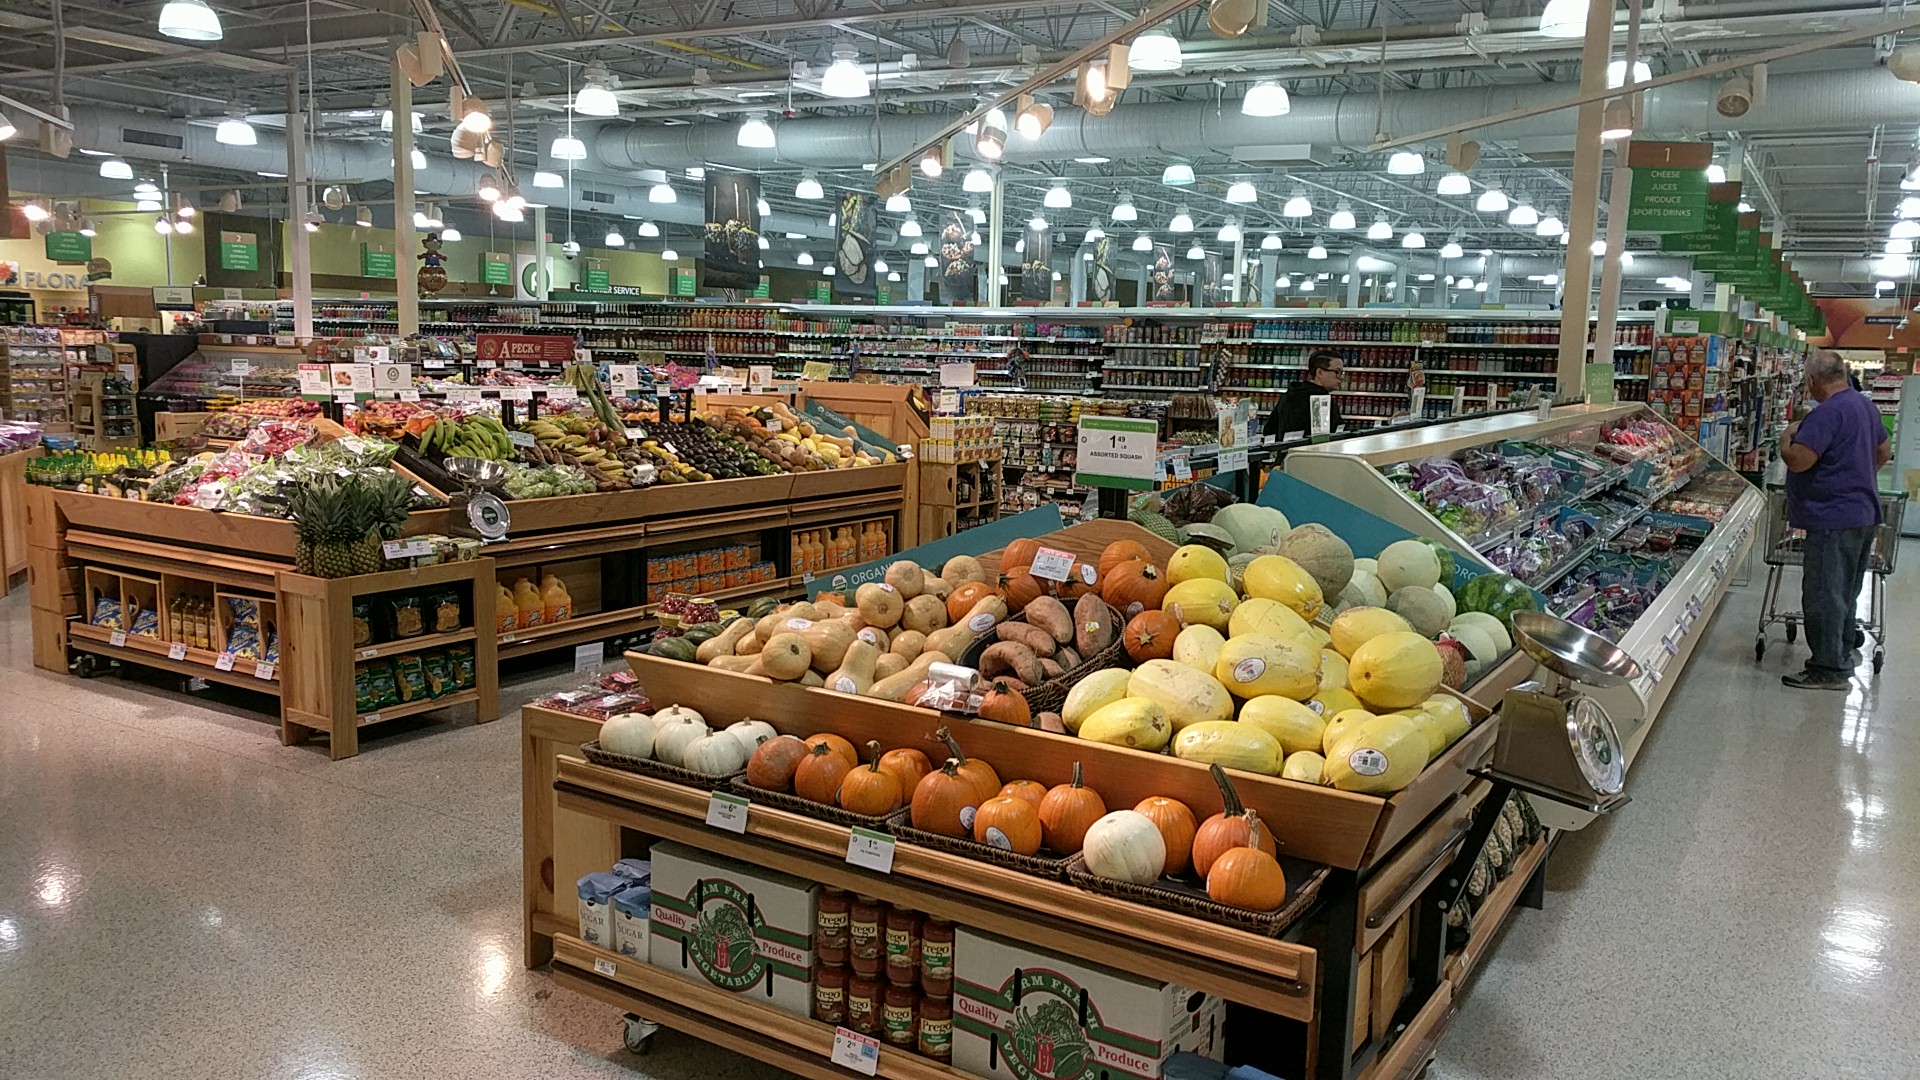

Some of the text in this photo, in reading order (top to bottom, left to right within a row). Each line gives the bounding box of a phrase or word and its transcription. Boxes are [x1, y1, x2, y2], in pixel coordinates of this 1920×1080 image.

[1664, 147, 1671, 162] 1
[1650, 170, 1681, 179] CHEESE
[1651, 183, 1677, 191] JUICES
[1644, 196, 1681, 204] PRODUCE
[1632, 208, 1691, 217] SPORTS DRINKS
[613, 285, 641, 296] SERVICE
[498, 340, 511, 359] A
[511, 342, 535, 354] PECK
[796, 412, 820, 428] ORGANIC
[824, 411, 847, 426] ORGANIC
[1109, 434, 1116, 449] 1
[1089, 451, 1143, 460] ASSORTED SQUASH
[1656, 518, 1692, 528] ORGANIC
[687, 883, 764, 929] FRM FREH
[579, 910, 605, 927] SUGAR
[655, 906, 687, 929] Quality
[818, 911, 847, 929] Prego
[615, 920, 645, 940] SUGAR
[886, 931, 907, 946] rego
[762, 941, 803, 963] Produce
[921, 939, 950, 959] Prego
[690, 941, 762, 987] VEGETABLES
[849, 999, 869, 1013] rego
[958, 997, 1000, 1024] Quality
[1003, 974, 1100, 1031] FRM FREH
[921, 1018, 952, 1035] Prego
[1097, 1044, 1150, 1072] Produce
